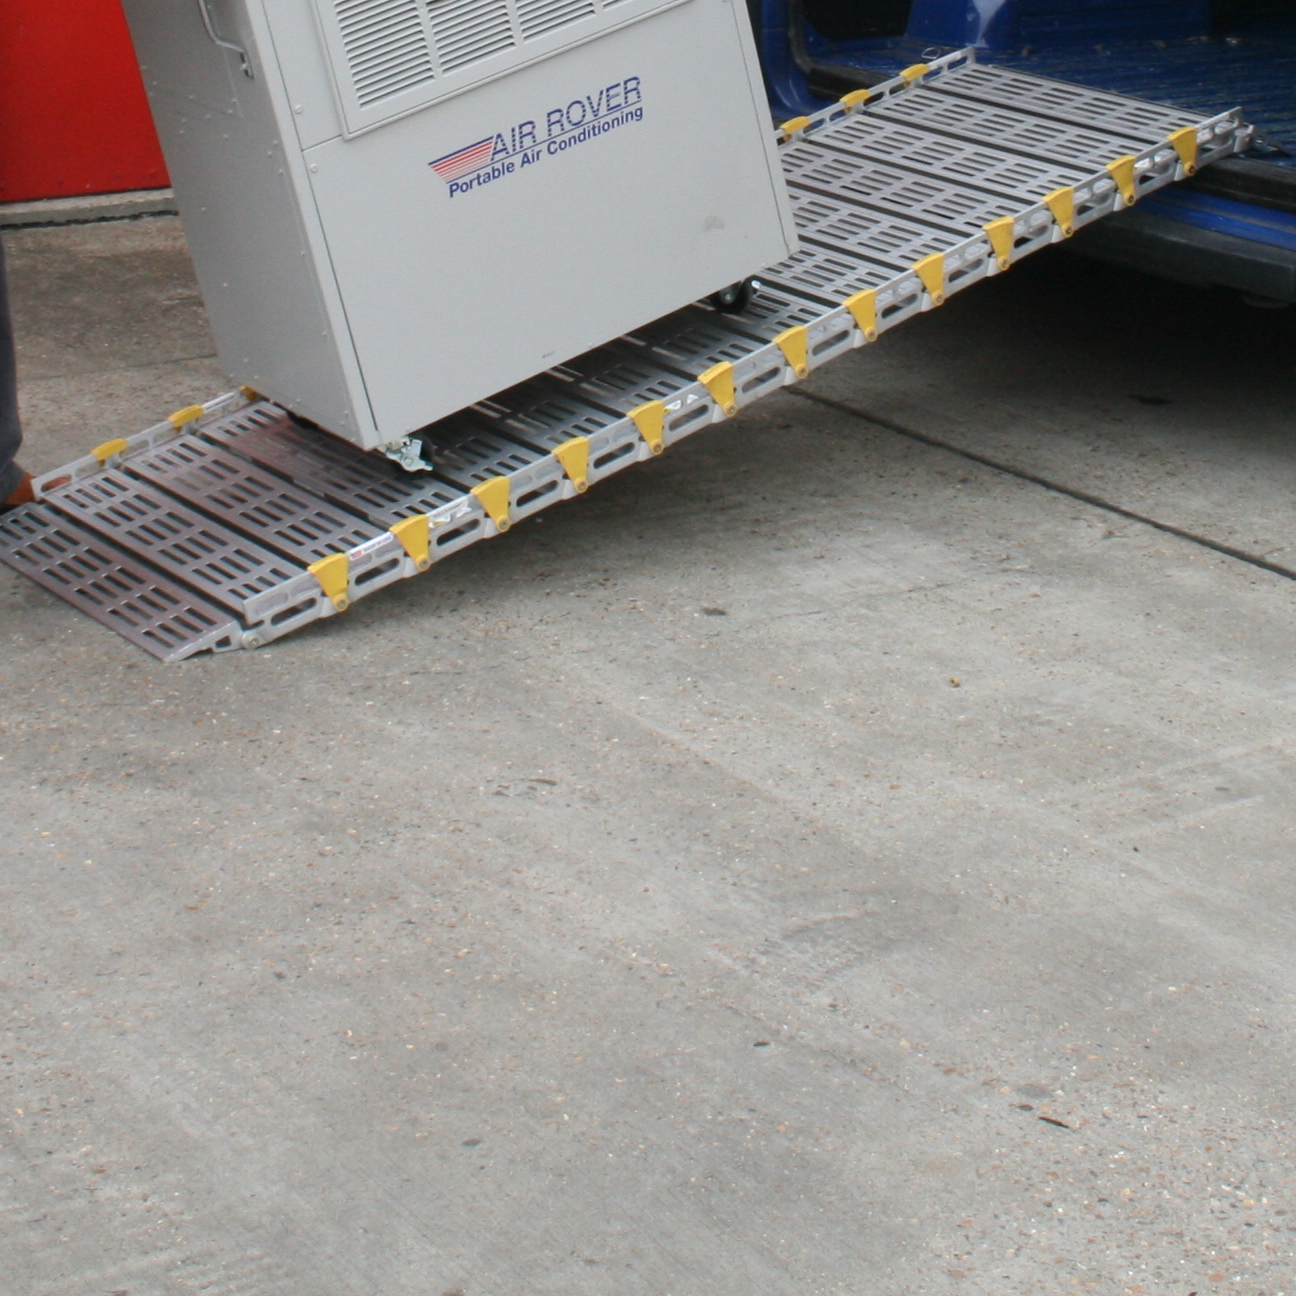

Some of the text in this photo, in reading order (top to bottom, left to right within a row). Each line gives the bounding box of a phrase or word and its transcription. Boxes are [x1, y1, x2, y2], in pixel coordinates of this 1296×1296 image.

[448, 106, 644, 198] Portable Air Conditioning
[490, 76, 642, 162] AIR ROVER
